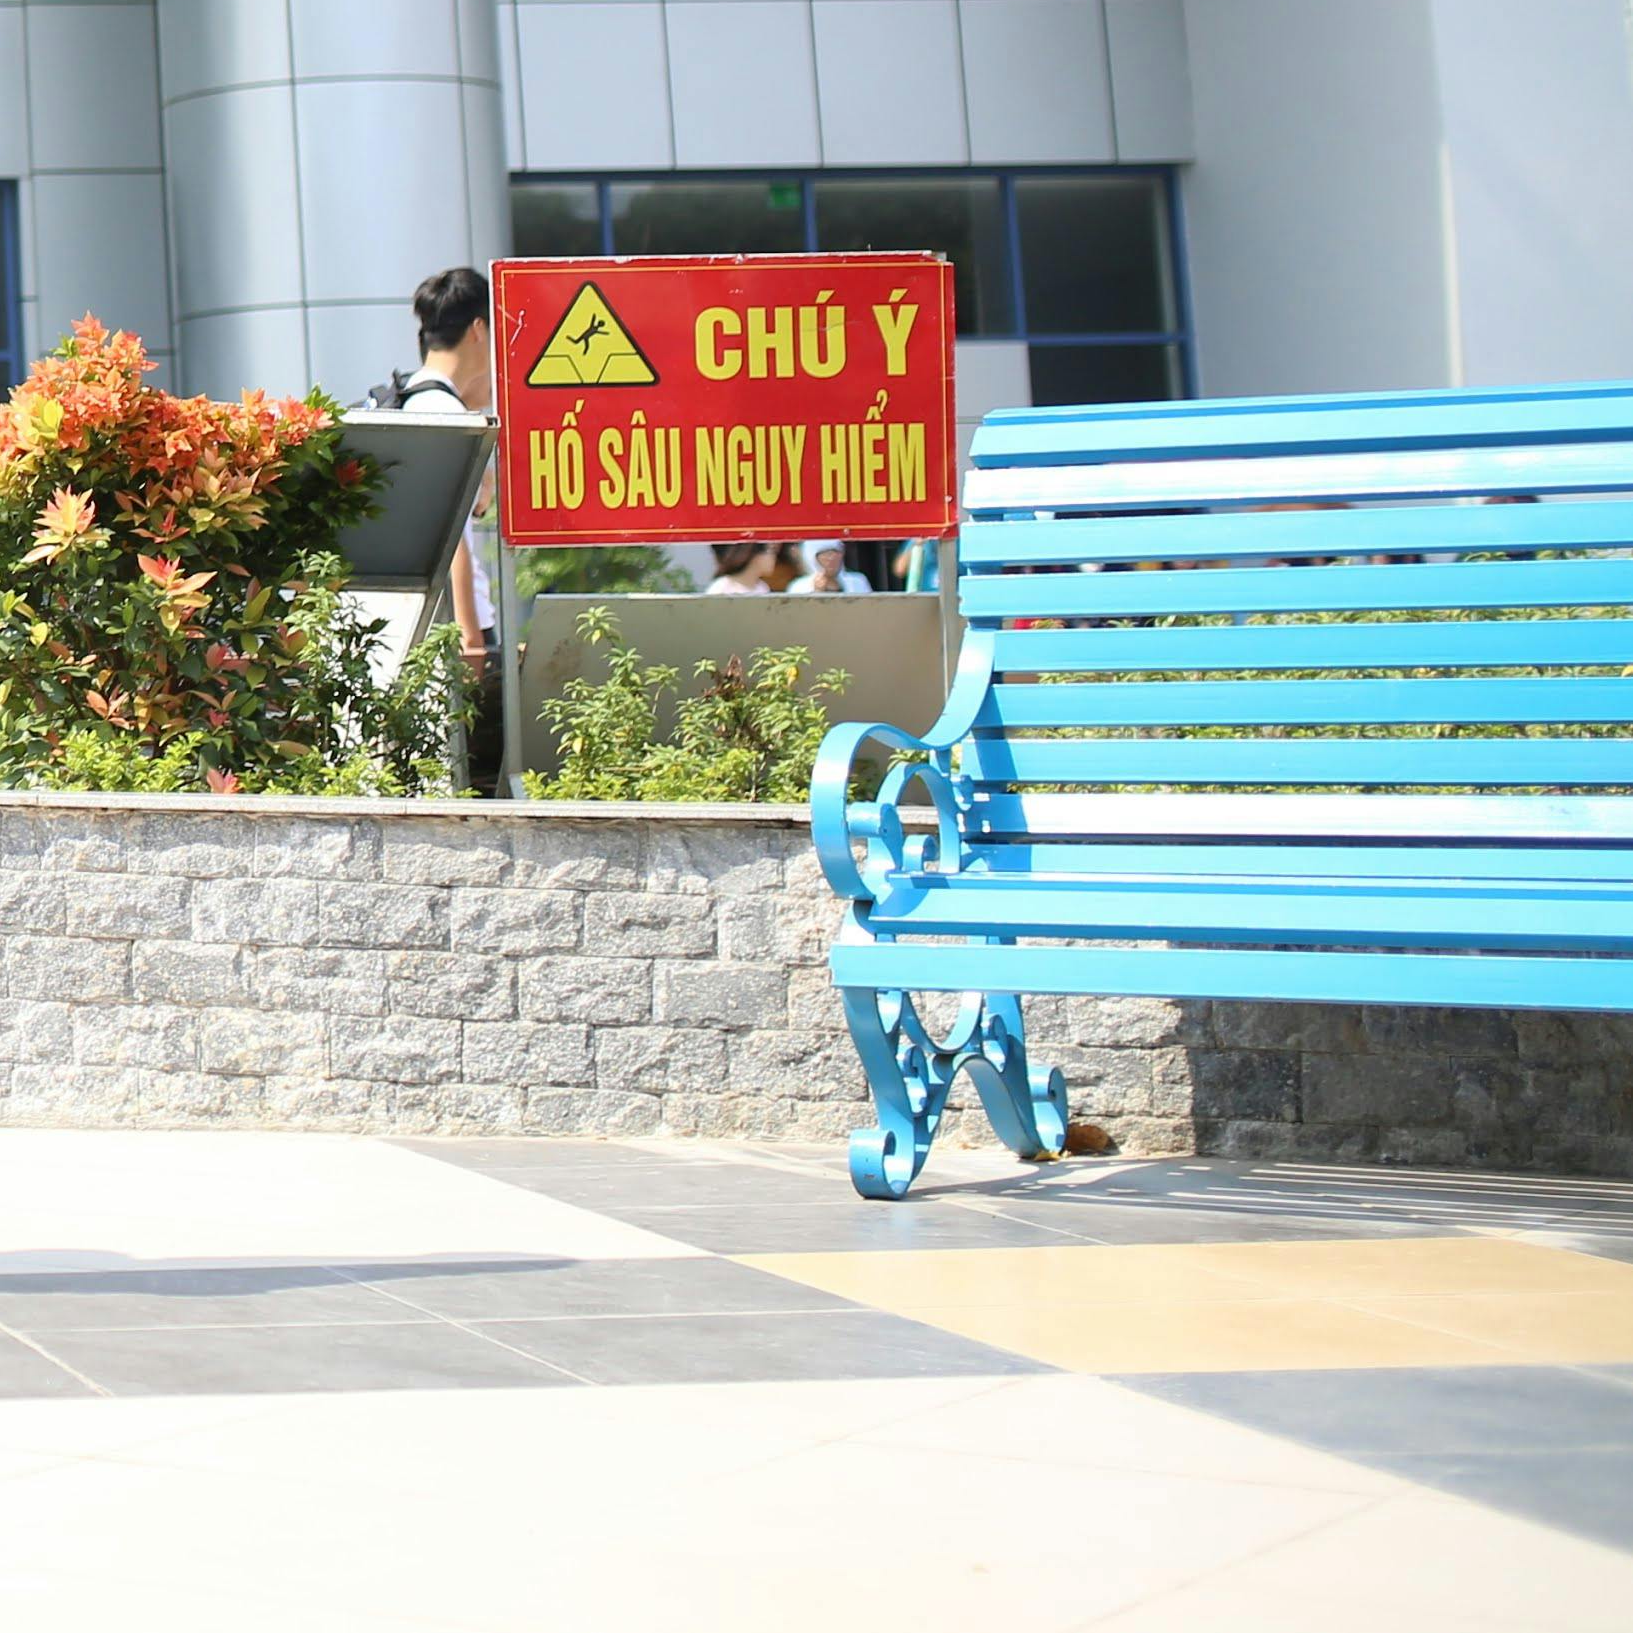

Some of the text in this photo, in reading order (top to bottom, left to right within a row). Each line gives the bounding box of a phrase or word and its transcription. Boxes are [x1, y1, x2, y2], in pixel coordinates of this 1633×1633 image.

[695, 289, 918, 379] CHÚ Ý
[530, 390, 925, 509] HỐ SÂU NGUY HIỂM
